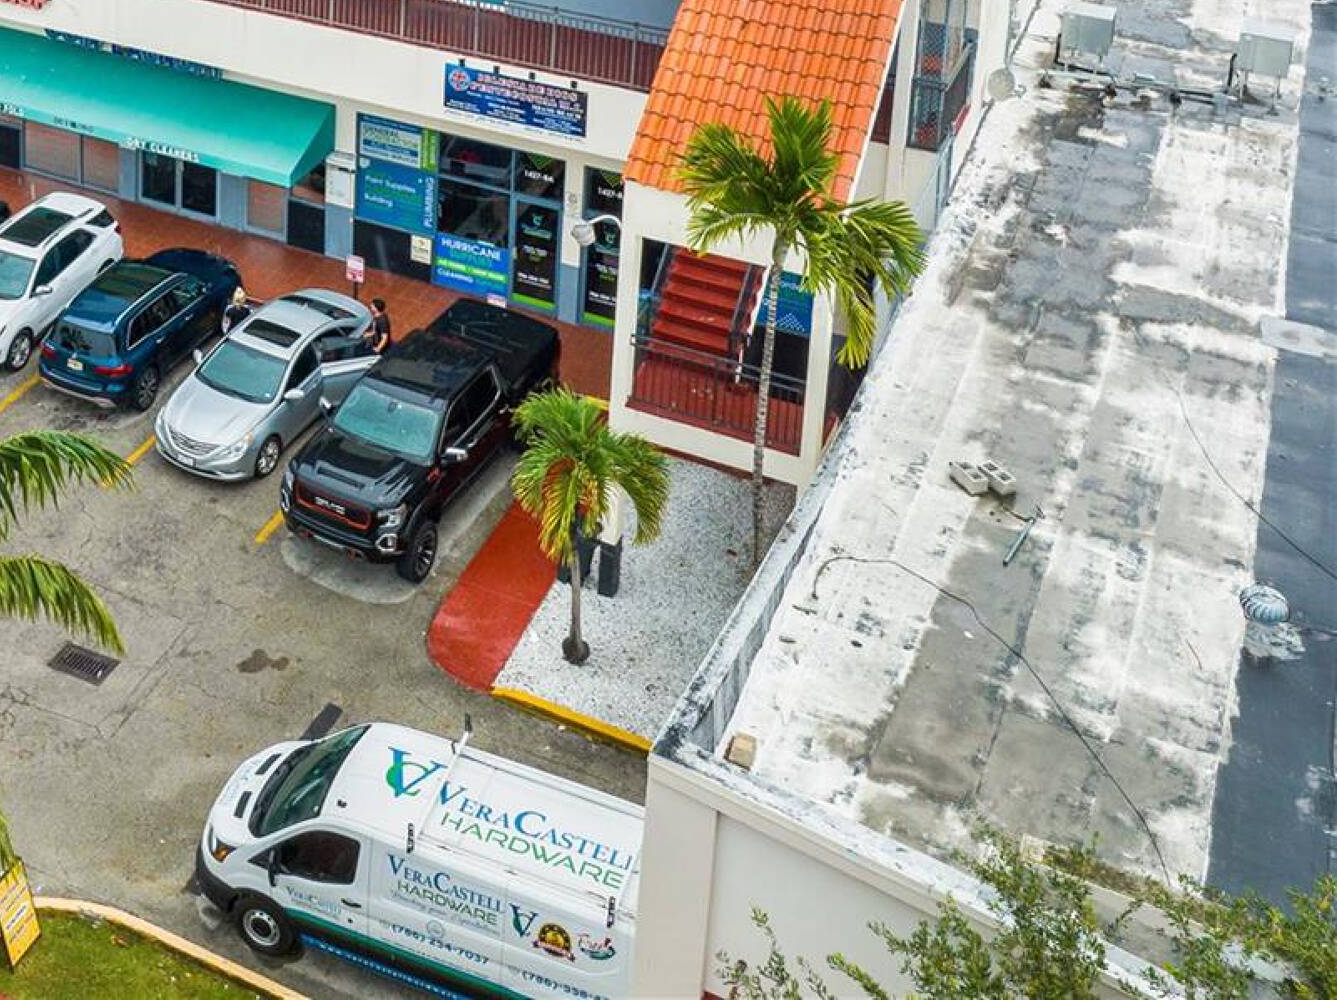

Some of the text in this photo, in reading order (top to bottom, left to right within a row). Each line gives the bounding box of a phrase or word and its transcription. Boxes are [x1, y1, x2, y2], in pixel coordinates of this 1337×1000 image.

[441, 237, 501, 261] HURRICANE
[440, 811, 625, 890] HARDWARE
[397, 880, 498, 927] HARDWARE
